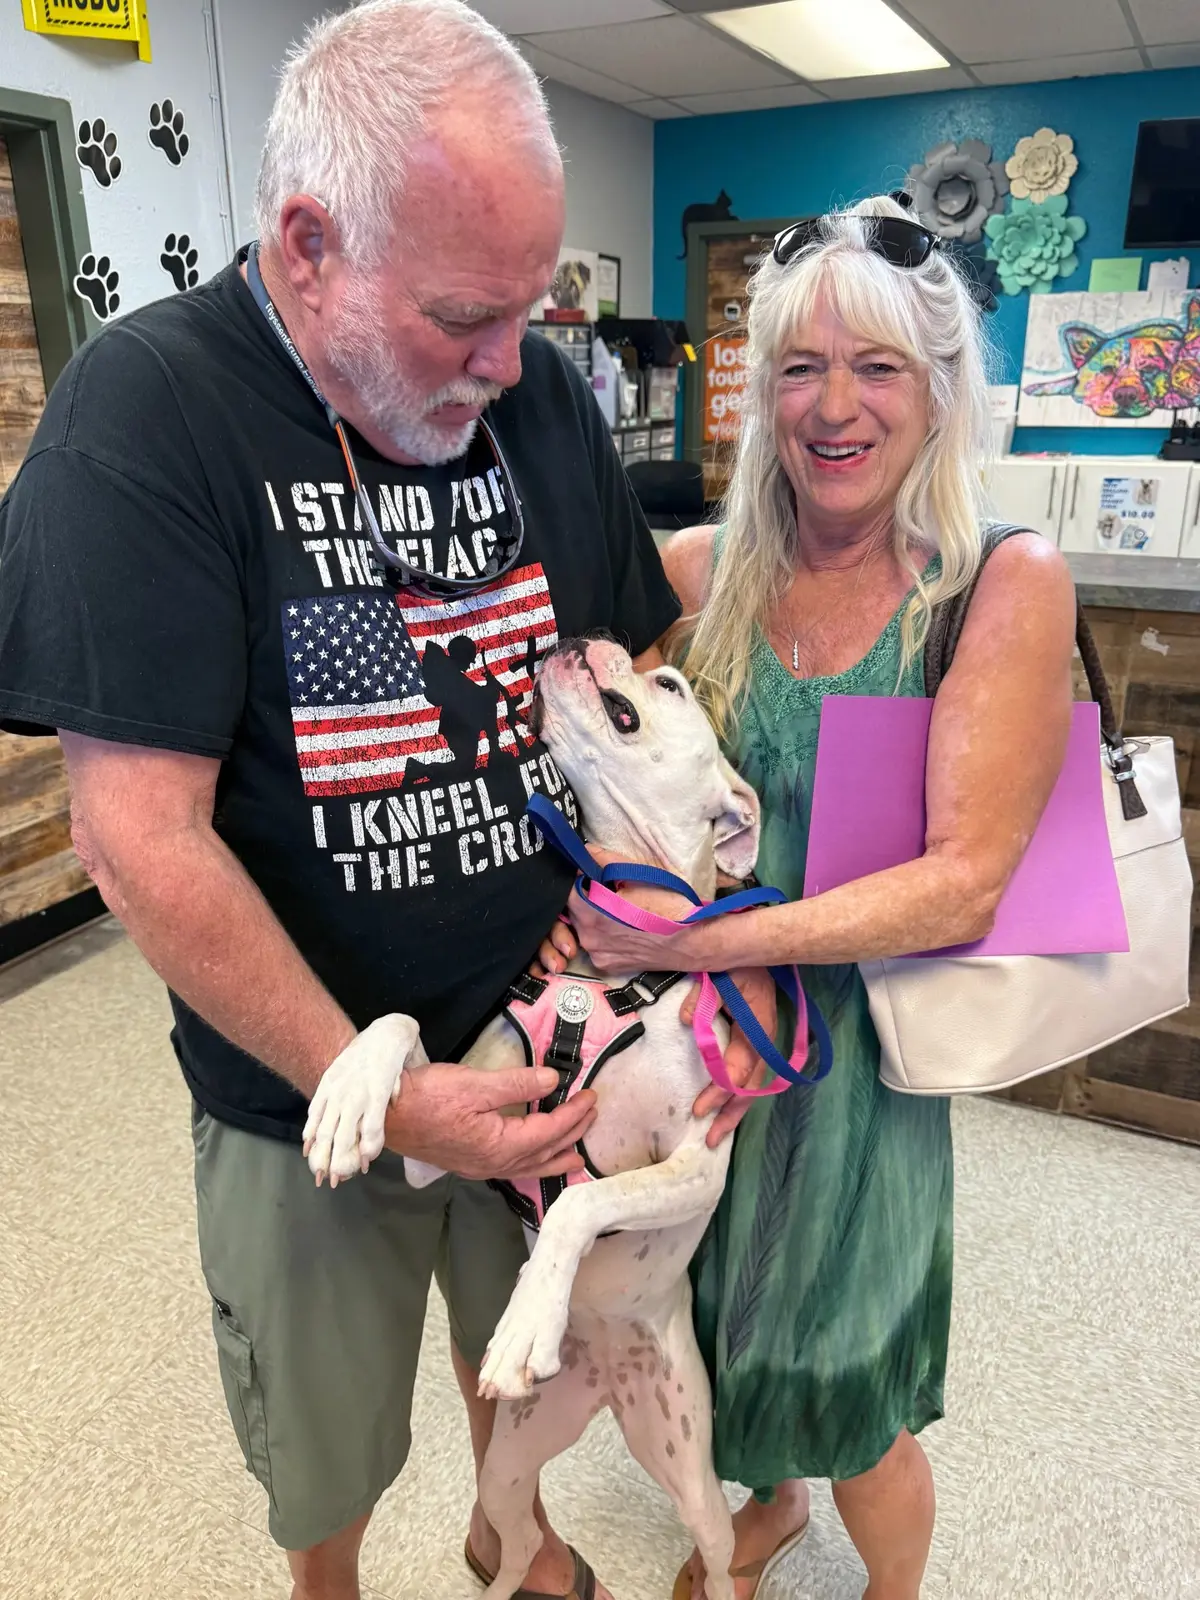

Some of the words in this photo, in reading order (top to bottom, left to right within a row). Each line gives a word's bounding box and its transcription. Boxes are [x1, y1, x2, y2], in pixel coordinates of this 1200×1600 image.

[714, 343, 748, 368] los
[265, 481, 284, 531] I
[303, 537, 383, 588] THE
[312, 805, 327, 849] I
[350, 777, 508, 847] KNEEL
[519, 752, 567, 800] FO
[333, 842, 435, 892] THE
[457, 791, 578, 876] CROS
